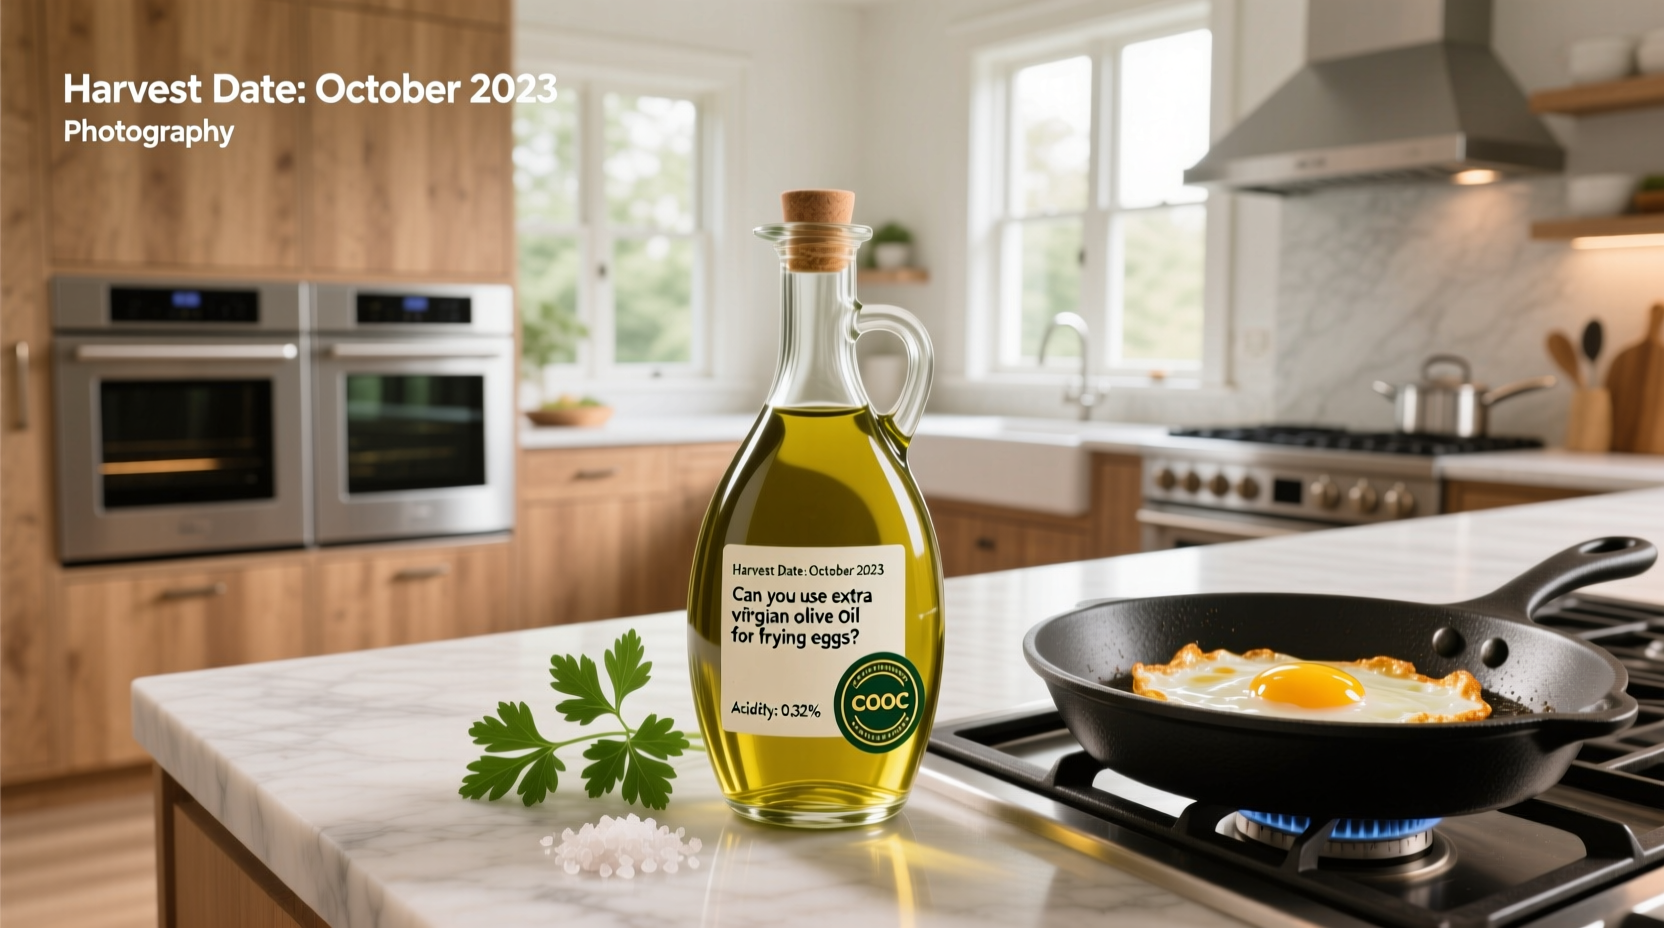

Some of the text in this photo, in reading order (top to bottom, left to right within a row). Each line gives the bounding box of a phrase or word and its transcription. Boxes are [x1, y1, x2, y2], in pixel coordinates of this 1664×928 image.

[732, 564, 885, 577] Harvest Date: October 2023
[732, 586, 873, 607] Can you use extra
[794, 607, 834, 624] olive
[731, 626, 860, 649] for frying eggs?
[731, 701, 821, 720] Acidity: 0.32%
[851, 692, 909, 711] COOC
